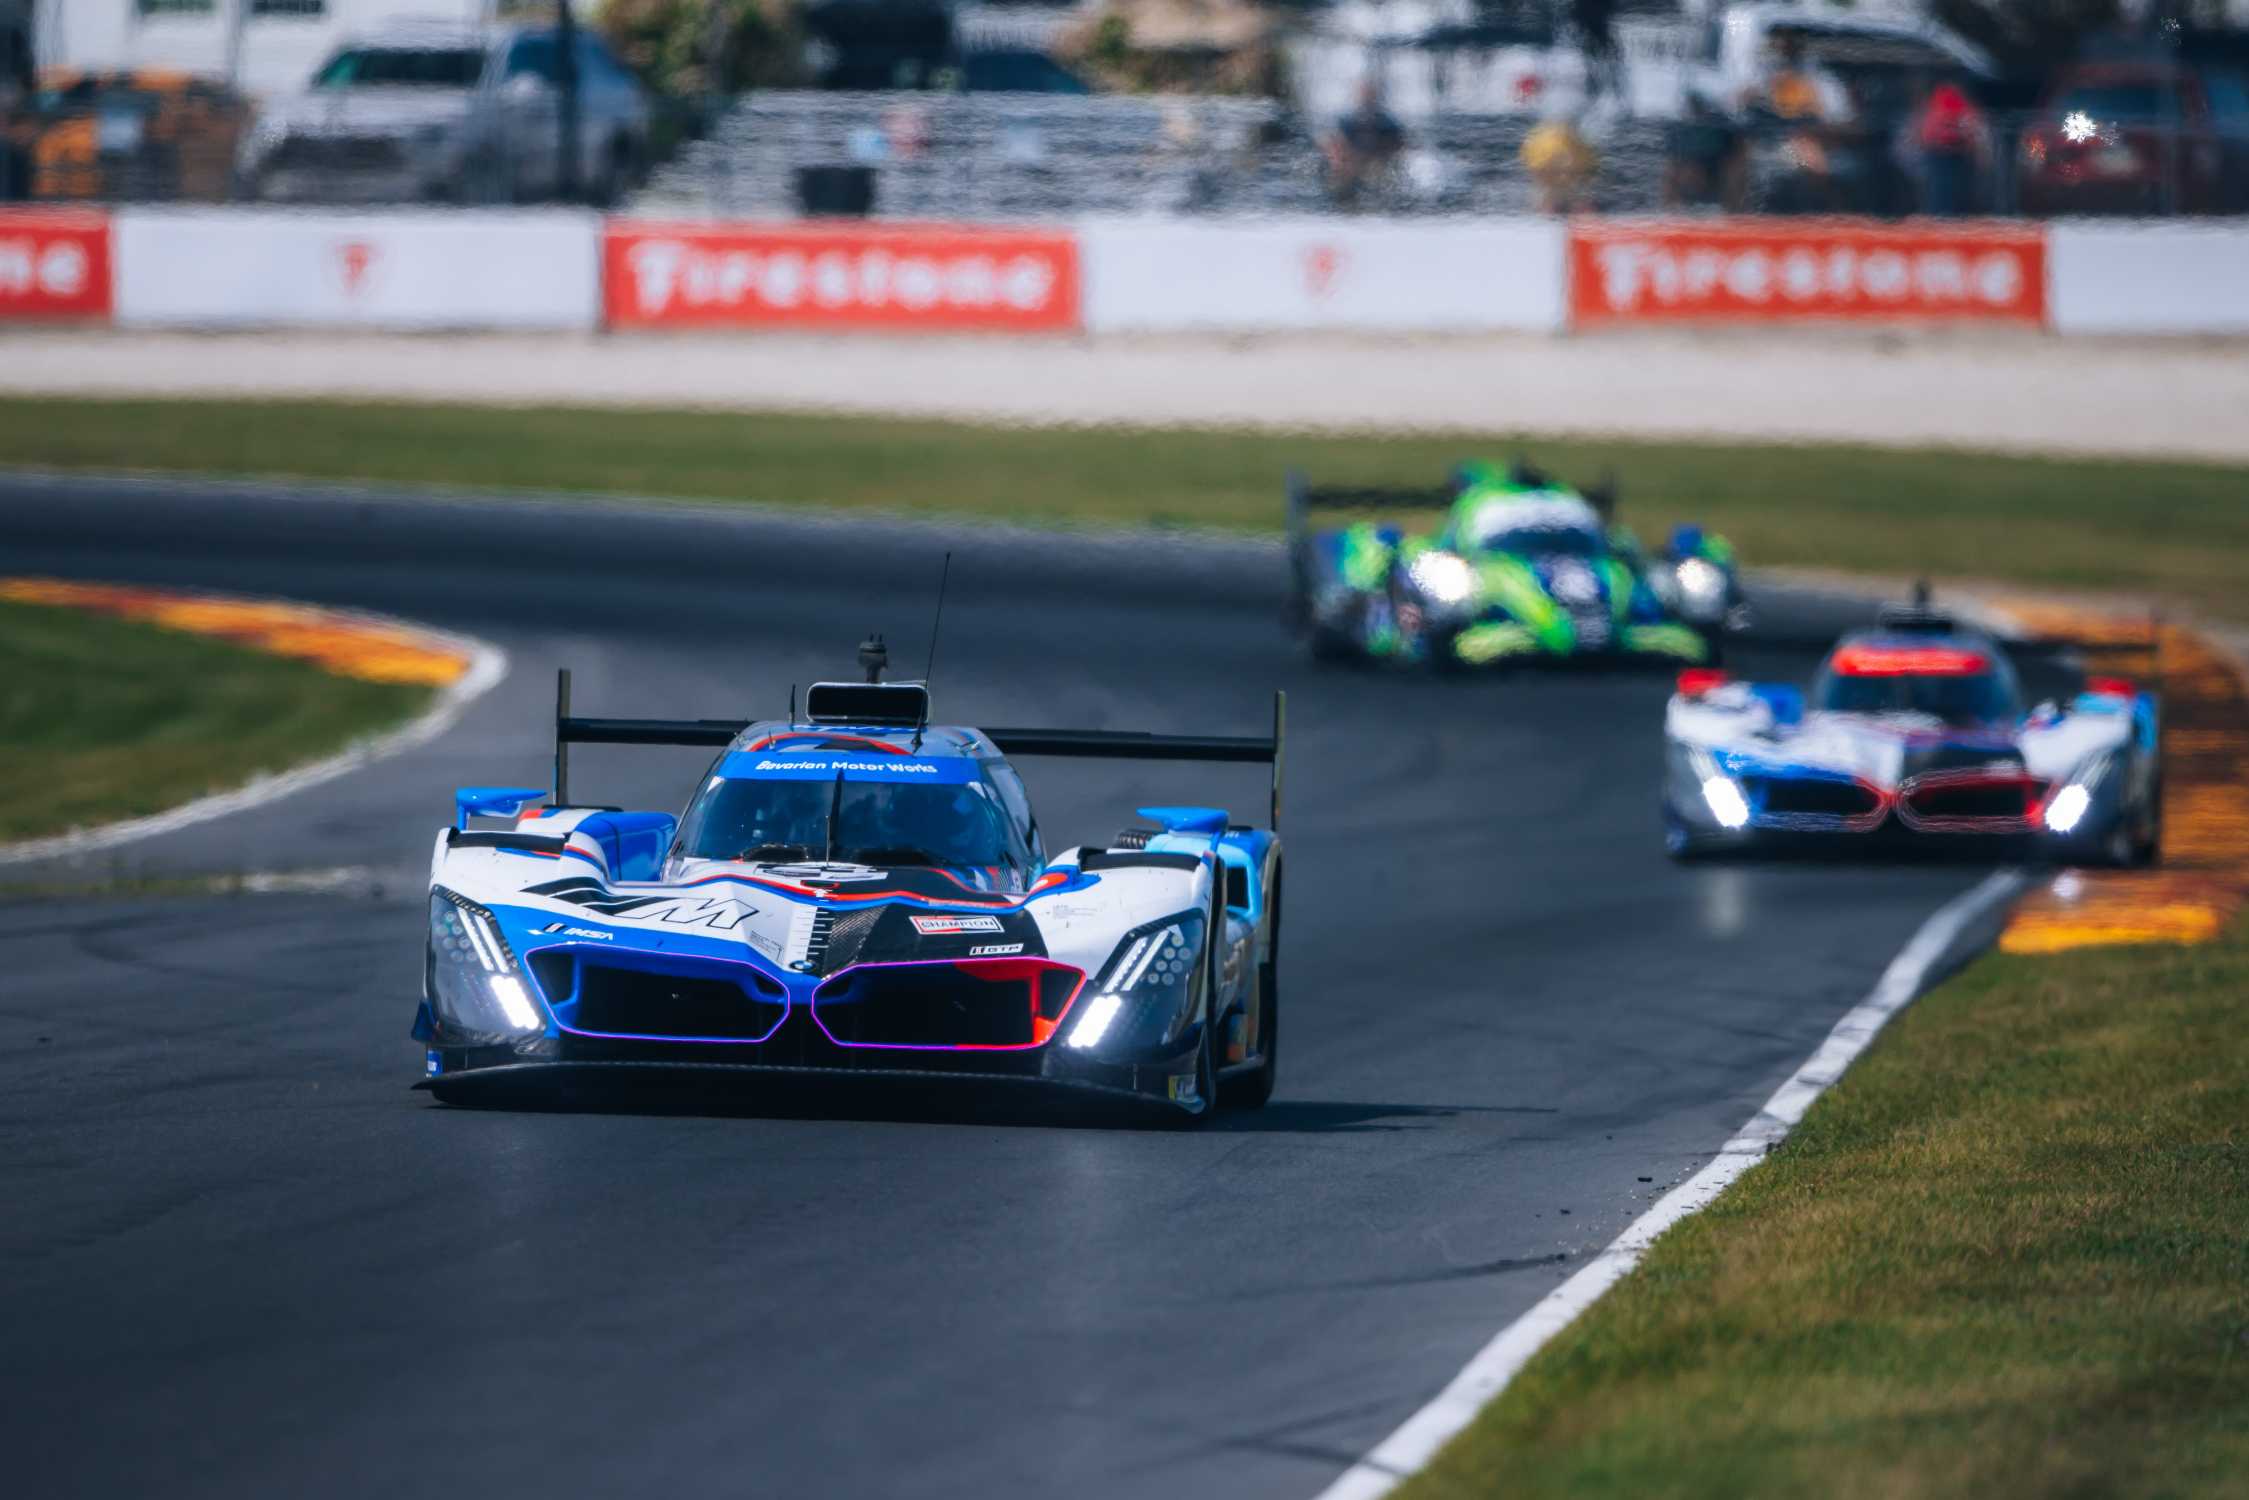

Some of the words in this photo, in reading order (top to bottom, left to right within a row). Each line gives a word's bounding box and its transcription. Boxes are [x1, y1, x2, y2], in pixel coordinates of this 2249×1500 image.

[755, 760, 826, 770] Bavarian
[832, 761, 884, 771] Motor
[886, 763, 938, 773] Works
[563, 928, 614, 940] IMSA
